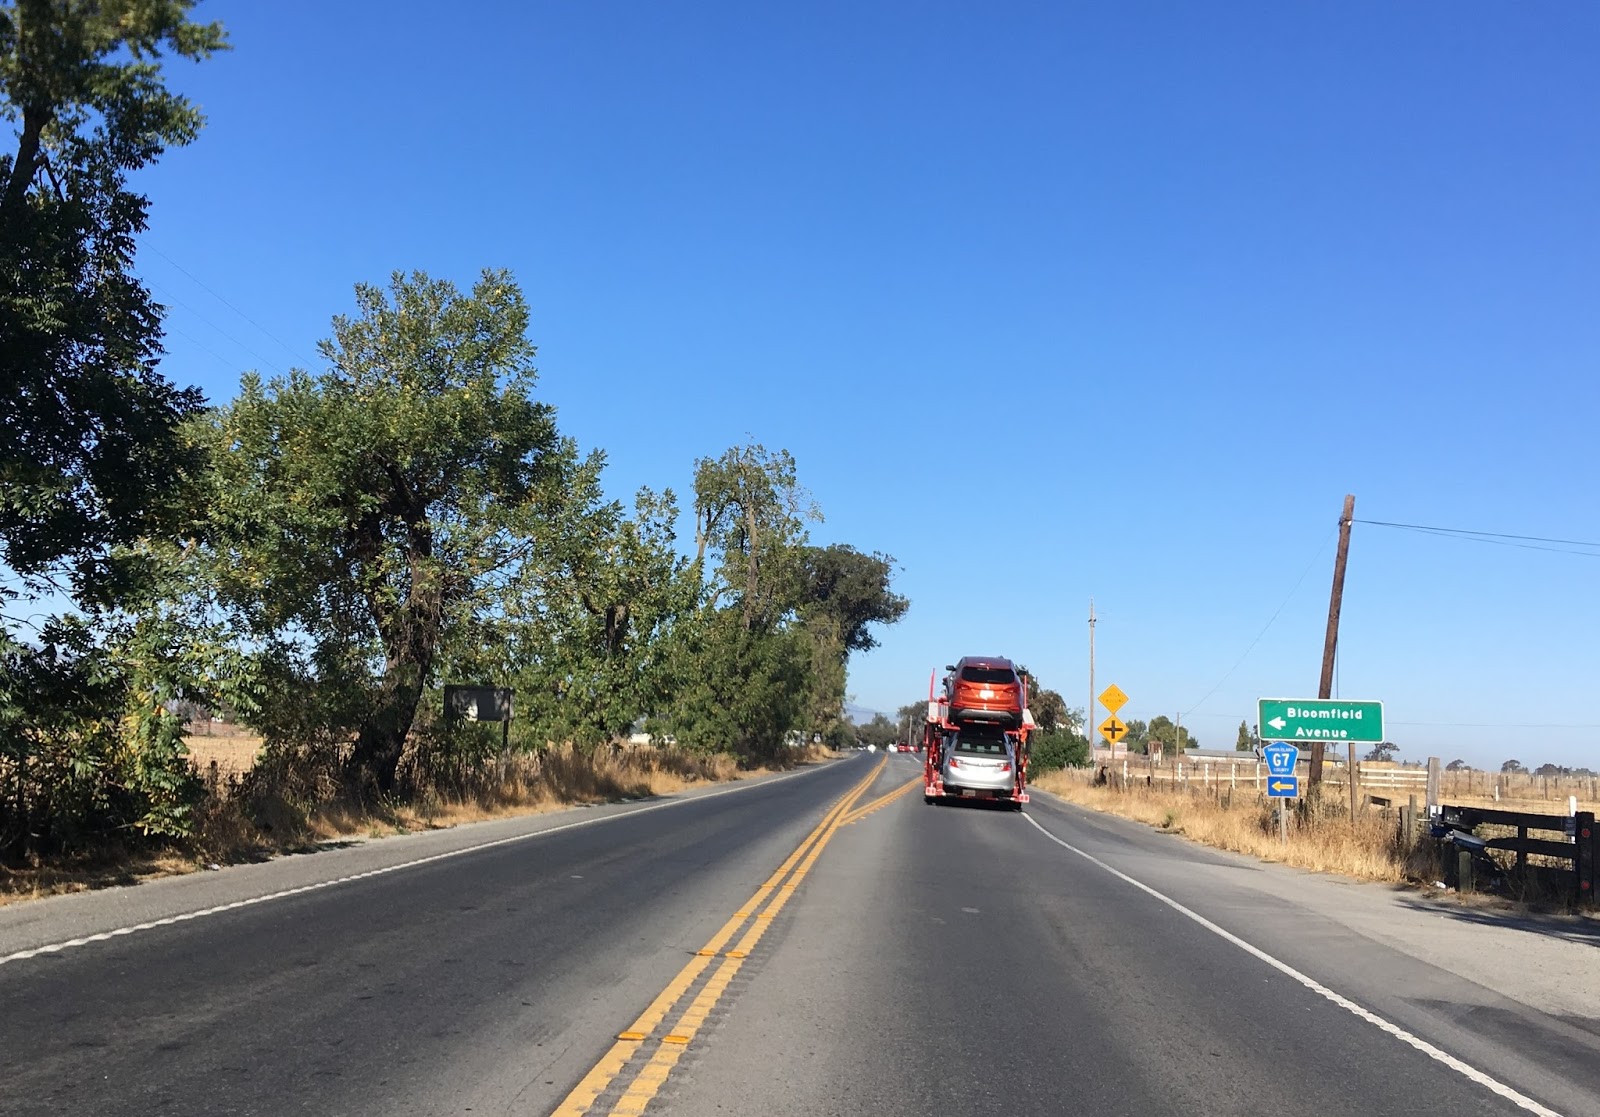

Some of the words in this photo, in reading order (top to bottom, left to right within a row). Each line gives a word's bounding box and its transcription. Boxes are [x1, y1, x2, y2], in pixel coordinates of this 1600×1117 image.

[1287, 707, 1362, 719] Bloomfield
[1295, 727, 1348, 738] Avenue
[1273, 753, 1290, 767] G7
